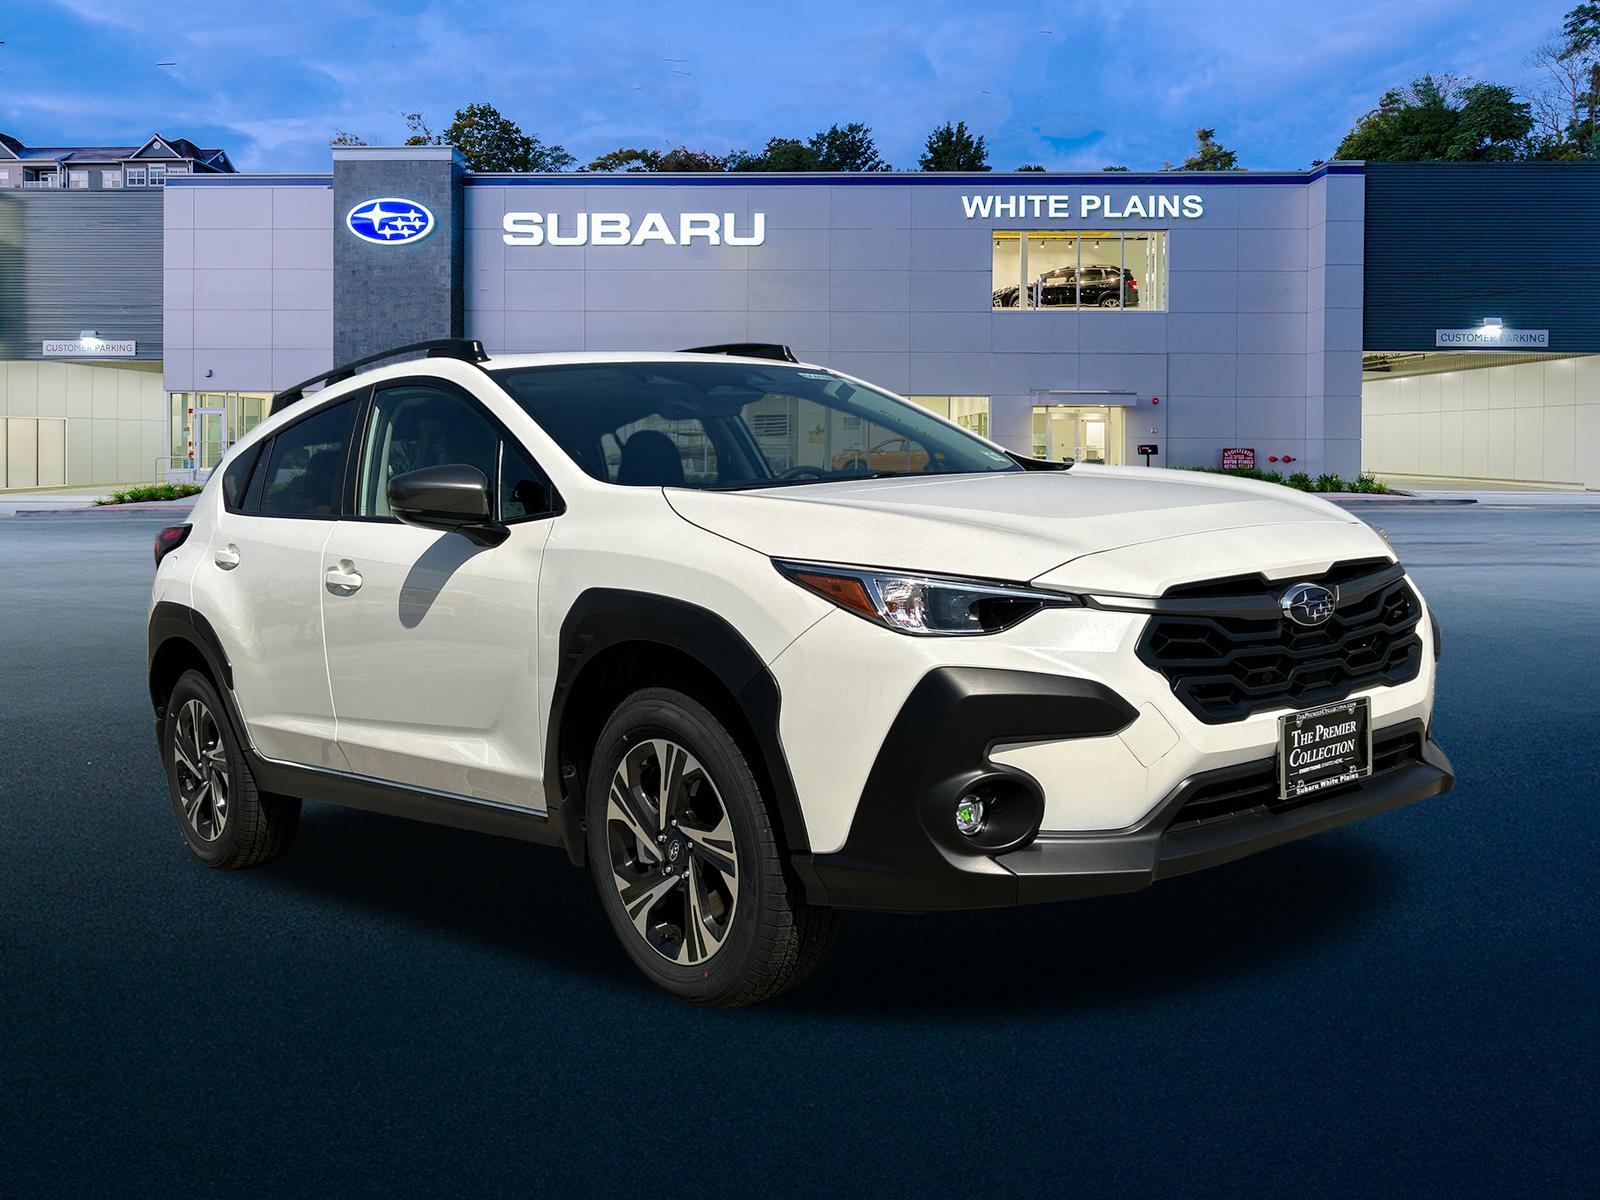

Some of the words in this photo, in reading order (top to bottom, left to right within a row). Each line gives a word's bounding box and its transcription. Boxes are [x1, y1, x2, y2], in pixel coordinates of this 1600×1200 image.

[961, 195, 1070, 219] WHITE
[1080, 194, 1205, 219] PLAINS
[502, 212, 765, 246] SUBARU
[94, 343, 133, 352] PARKING
[1501, 333, 1545, 343] PARKING
[1291, 729, 1315, 748] THE
[1315, 720, 1357, 742] PREMIER
[1289, 739, 1355, 767] COLLECTION
[1296, 783, 1319, 795] Subaru
[1320, 777, 1339, 788] White
[1340, 772, 1360, 782] Plains
